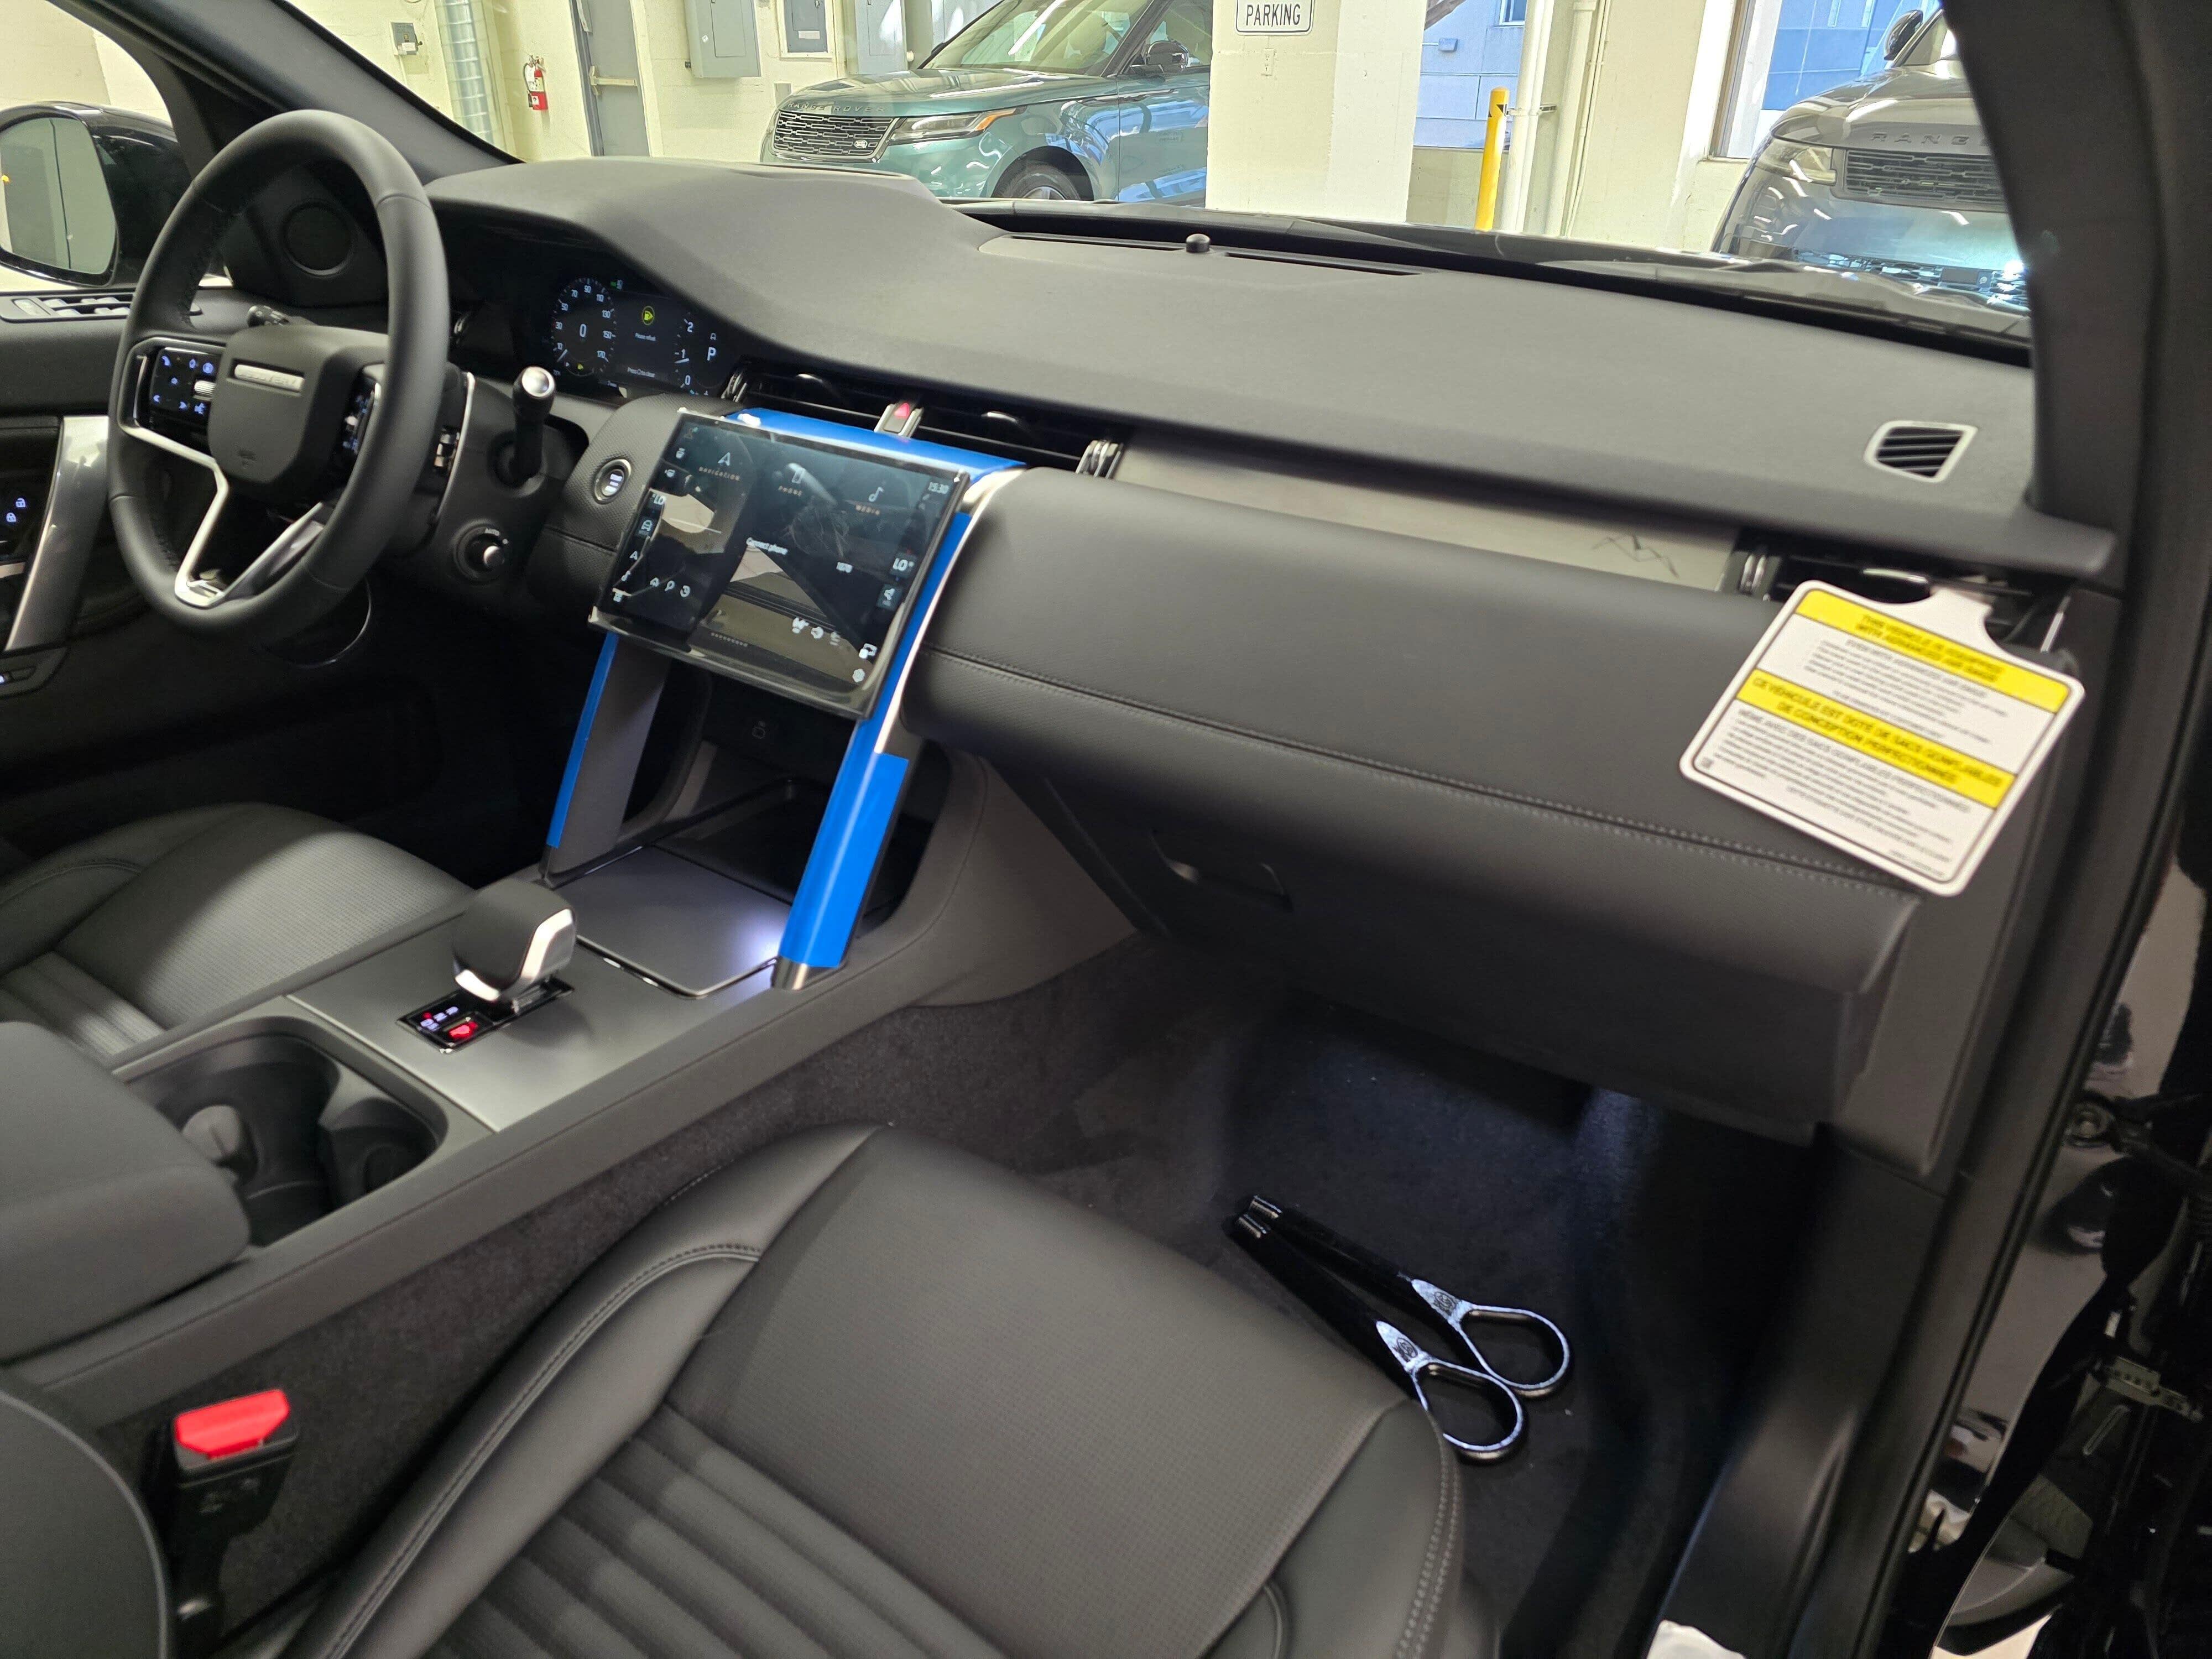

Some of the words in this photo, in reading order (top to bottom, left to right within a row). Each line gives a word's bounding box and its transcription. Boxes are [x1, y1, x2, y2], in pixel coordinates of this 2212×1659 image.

[1246, 4, 1301, 27] PARKING
[788, 102, 825, 111] RANGE
[1870, 132, 1985, 145] RANG
[580, 324, 587, 337] 0
[687, 322, 693, 332] 2
[707, 347, 716, 361] P
[685, 375, 691, 385] 0
